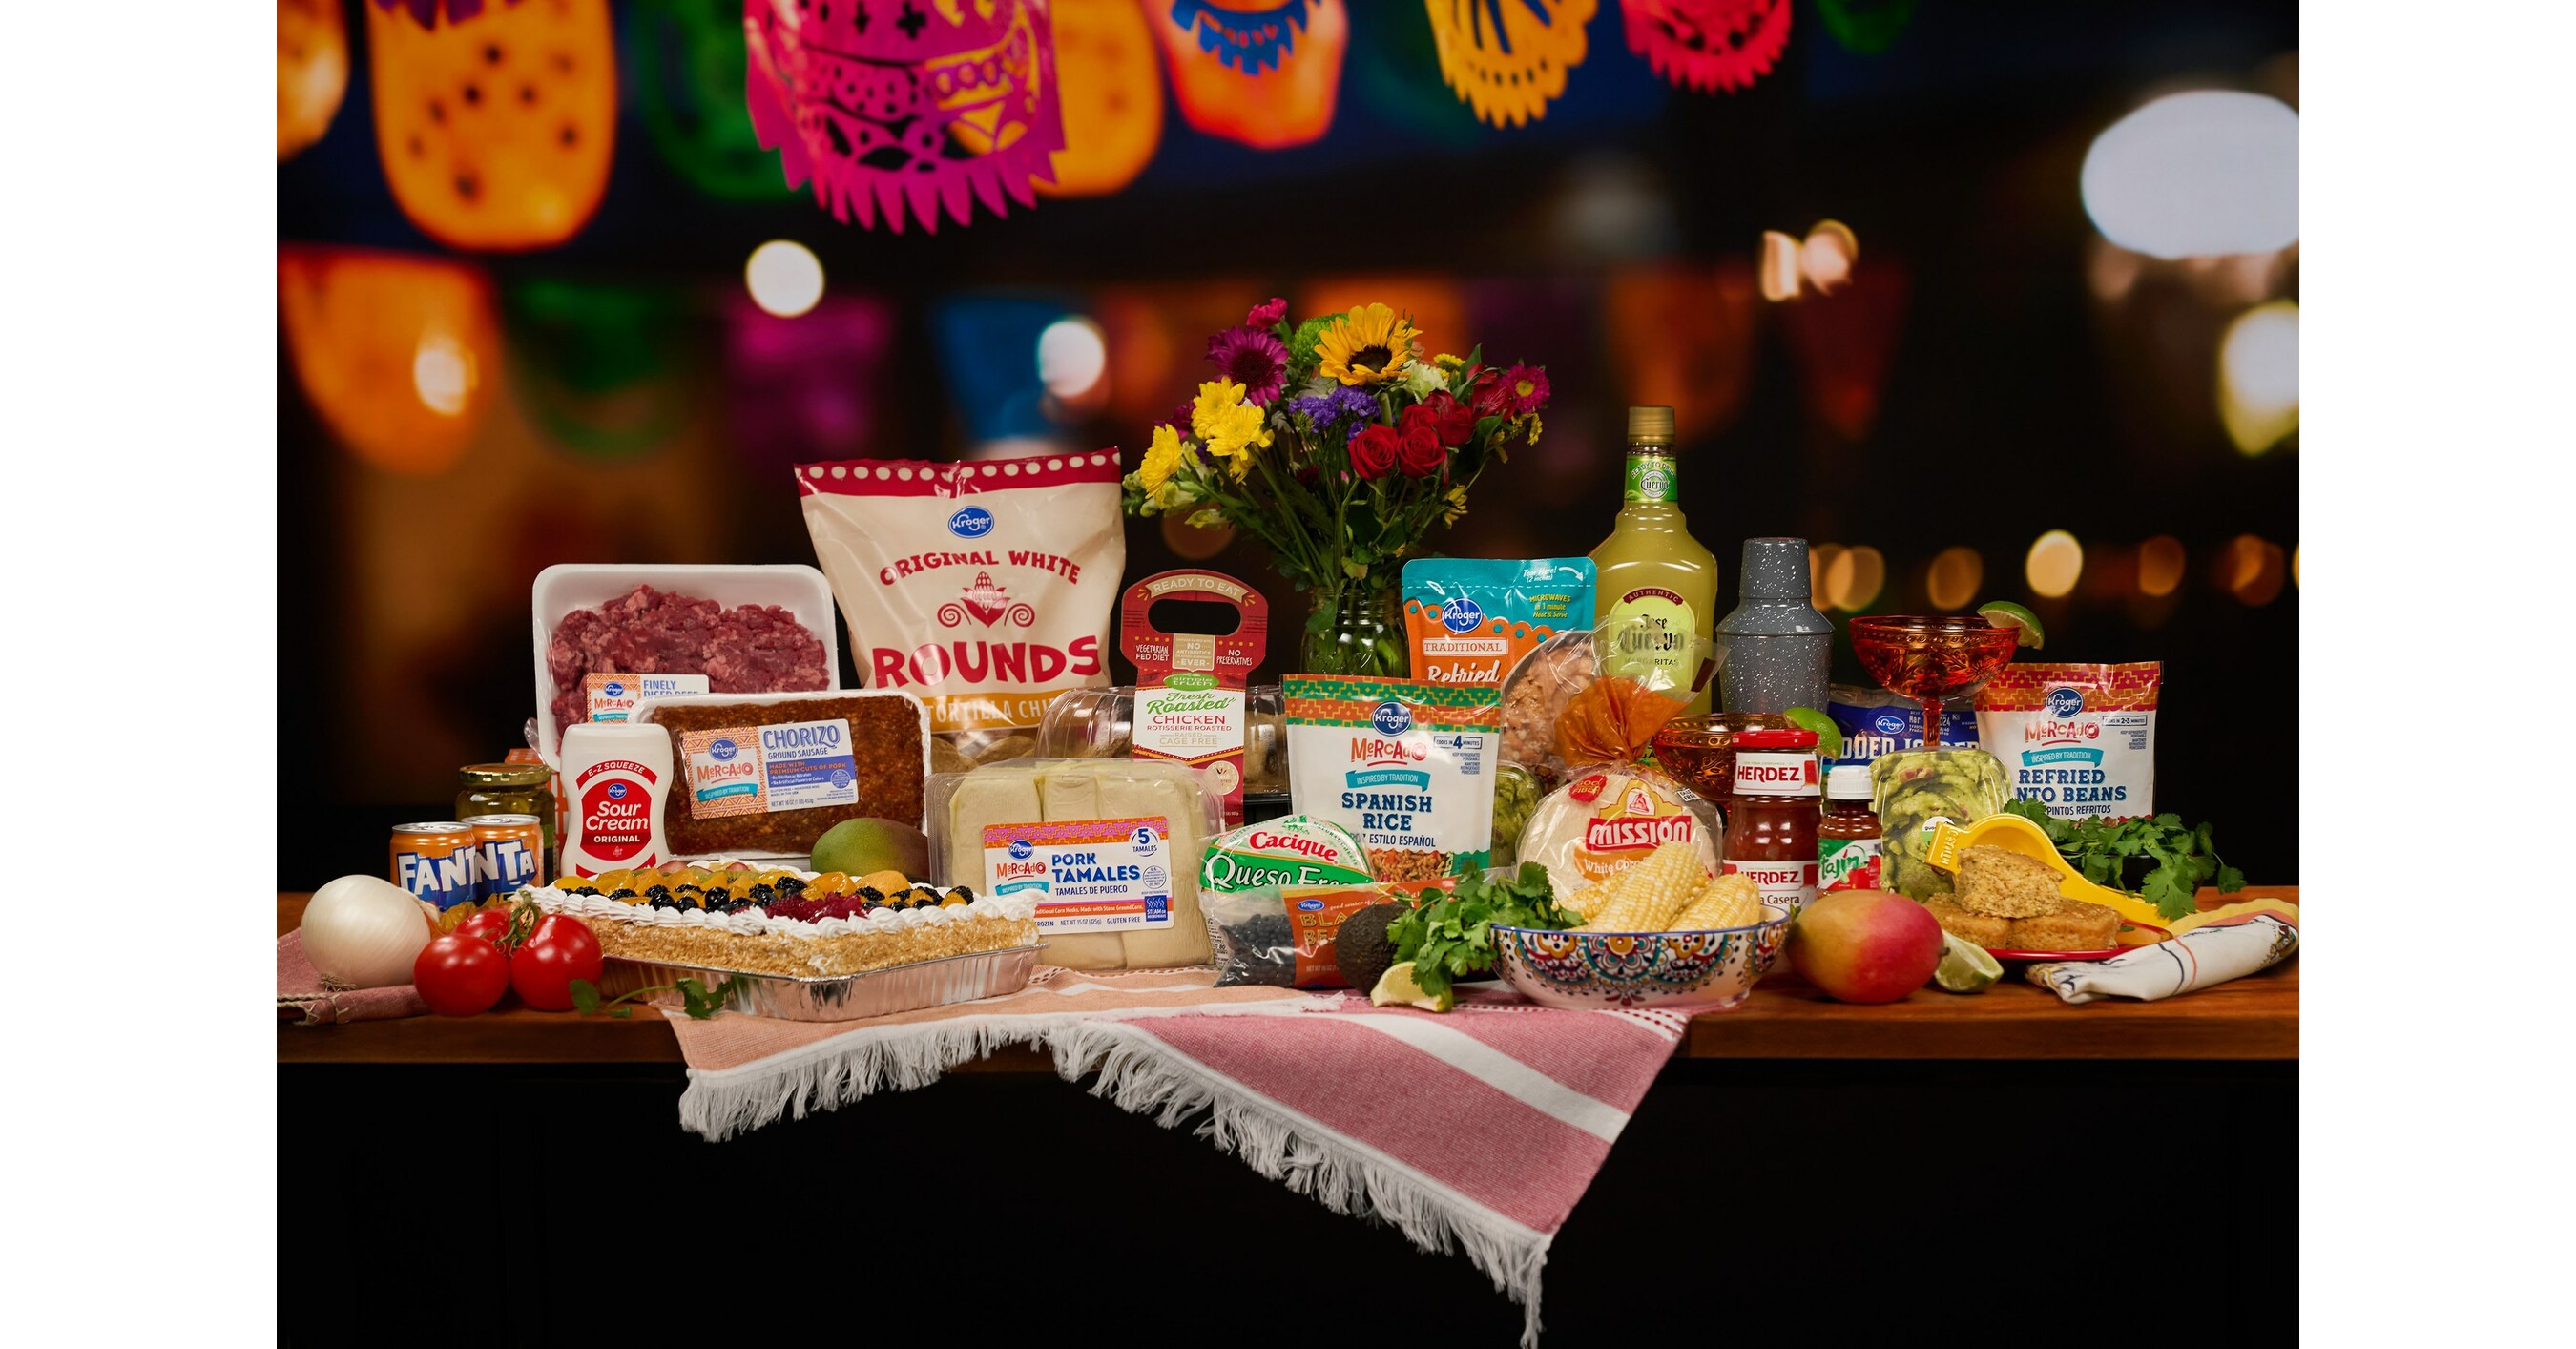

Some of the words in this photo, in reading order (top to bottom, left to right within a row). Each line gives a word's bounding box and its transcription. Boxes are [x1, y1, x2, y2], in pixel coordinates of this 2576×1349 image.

[1631, 462, 1650, 479] READY
[1641, 478, 1669, 491] Cuervo
[952, 513, 990, 531] Kroger
[880, 550, 999, 585] ORIGINAL
[1008, 550, 1081, 585] WHITE
[1153, 578, 1195, 592] READY
[1197, 578, 1214, 588] TO
[1217, 582, 1241, 596] EAT
[1529, 593, 1571, 603] MICROWAVES
[1629, 589, 1679, 602] AUTHENTIC
[1444, 606, 1480, 626] Kroger
[1135, 644, 1169, 654] VEGETARIAN
[1424, 642, 1503, 652] TRADITIONAL
[872, 635, 1102, 690] ROUNDS
[1216, 656, 1253, 666] PRESERVATIVES
[1428, 659, 1501, 682] Refried
[643, 680, 676, 690] FINELY
[1166, 692, 1215, 702] Fresh
[2047, 694, 2081, 711] Kroger
[926, 700, 1013, 724] TORTILLA
[1018, 697, 1055, 718] CHI
[1146, 697, 1232, 715] Roasted
[1153, 715, 1226, 724] CHICKEN
[1375, 709, 1409, 729] Kroger
[1878, 719, 1903, 730] Kroger
[763, 725, 840, 750] CHORIZO
[1453, 735, 1463, 749] 4
[711, 744, 736, 757] Kroger
[768, 751, 797, 760] GROUND
[798, 748, 828, 758] SAUSAGE
[2031, 753, 2056, 763] INSPIRED
[2063, 751, 2091, 759] TRADITION
[588, 764, 603, 777] E-Z
[604, 761, 645, 774] SQUEEZE
[1737, 766, 1800, 783] HERDEZ
[2018, 769, 2105, 784] REFRIED
[1357, 774, 1381, 784] INSPIRED
[1381, 774, 1388, 782] BY
[1389, 773, 1419, 783] TRADITION
[705, 788, 722, 799] INSPIRED
[2063, 786, 2127, 801] BEANS
[596, 801, 641, 817] Sour
[1341, 792, 1432, 812] SPANISH
[2046, 806, 2074, 816] PINTOS
[2076, 804, 2111, 814] REFRITOS
[586, 816, 648, 831] Cream
[1362, 813, 1412, 831] RICE
[593, 835, 640, 843] ORIGINAL
[1138, 828, 1150, 844] 5
[1369, 834, 1396, 845] ESTILO
[1399, 835, 1436, 847] ESPAÑOL
[1249, 831, 1338, 861] Cacique
[1052, 852, 1096, 866] PORK
[1584, 859, 1614, 874] White
[1052, 865, 1140, 883] TAMALES
[1204, 854, 1291, 889] Queso
[1741, 871, 1799, 885] ERDEZ
[1055, 887, 1087, 896] TAMALES
[1090, 886, 1098, 895] DE
[1100, 884, 1128, 894] PUERCO
[1767, 895, 1799, 904] Casera
[1299, 909, 1361, 927] BLA
